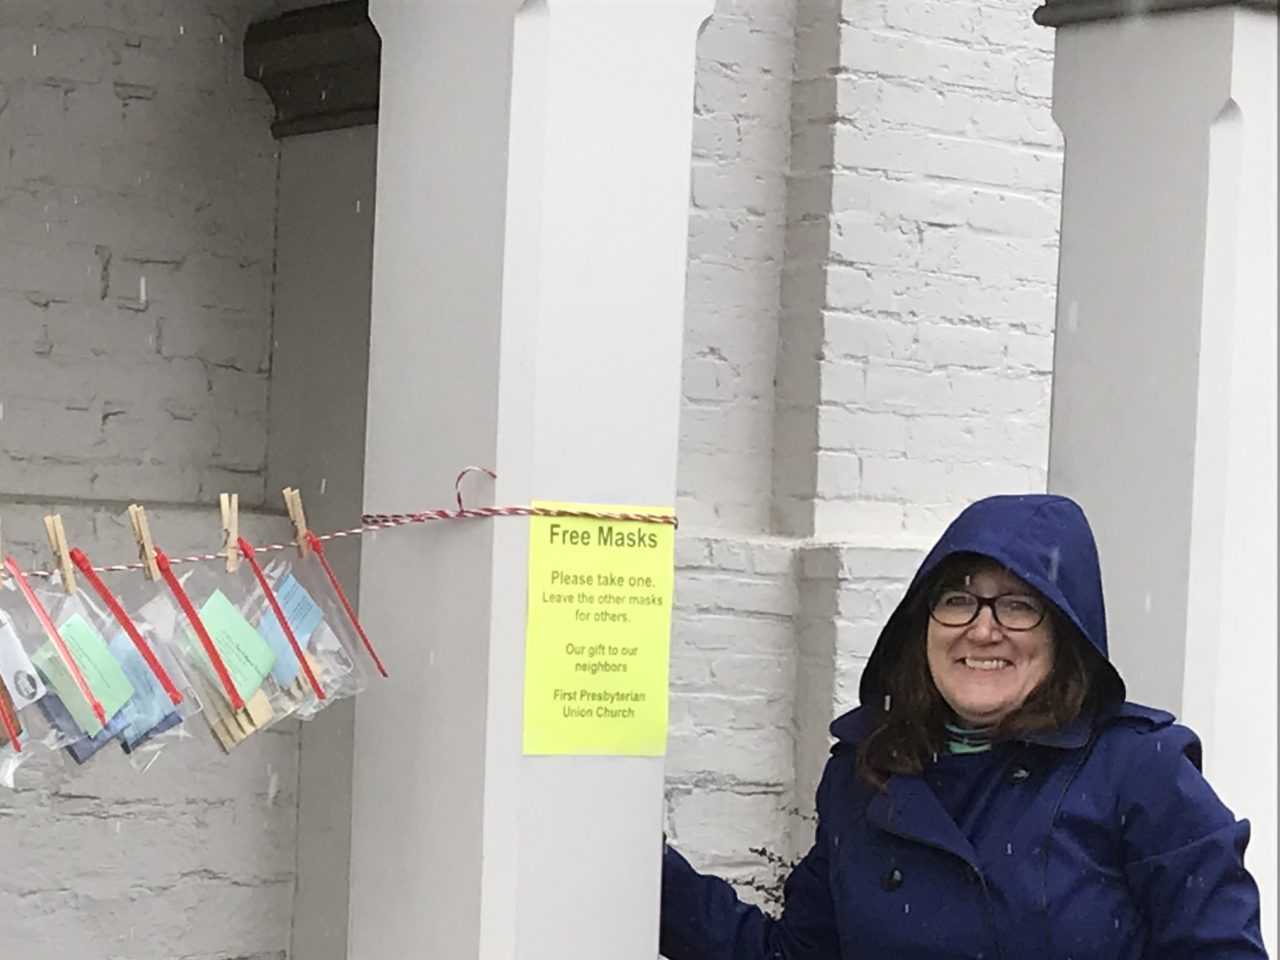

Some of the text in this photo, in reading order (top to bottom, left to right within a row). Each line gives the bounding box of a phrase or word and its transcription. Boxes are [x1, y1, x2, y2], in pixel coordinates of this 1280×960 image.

[549, 523, 658, 549] Free Masks
[550, 570, 656, 588] Please take one.
[542, 591, 663, 607] Leave the other masks
[575, 609, 631, 623] for others.
[565, 643, 638, 659] Our gift to our
[574, 661, 628, 675] neighbors
[553, 688, 646, 704] First Presbyterian
[563, 706, 635, 719] Union Church
